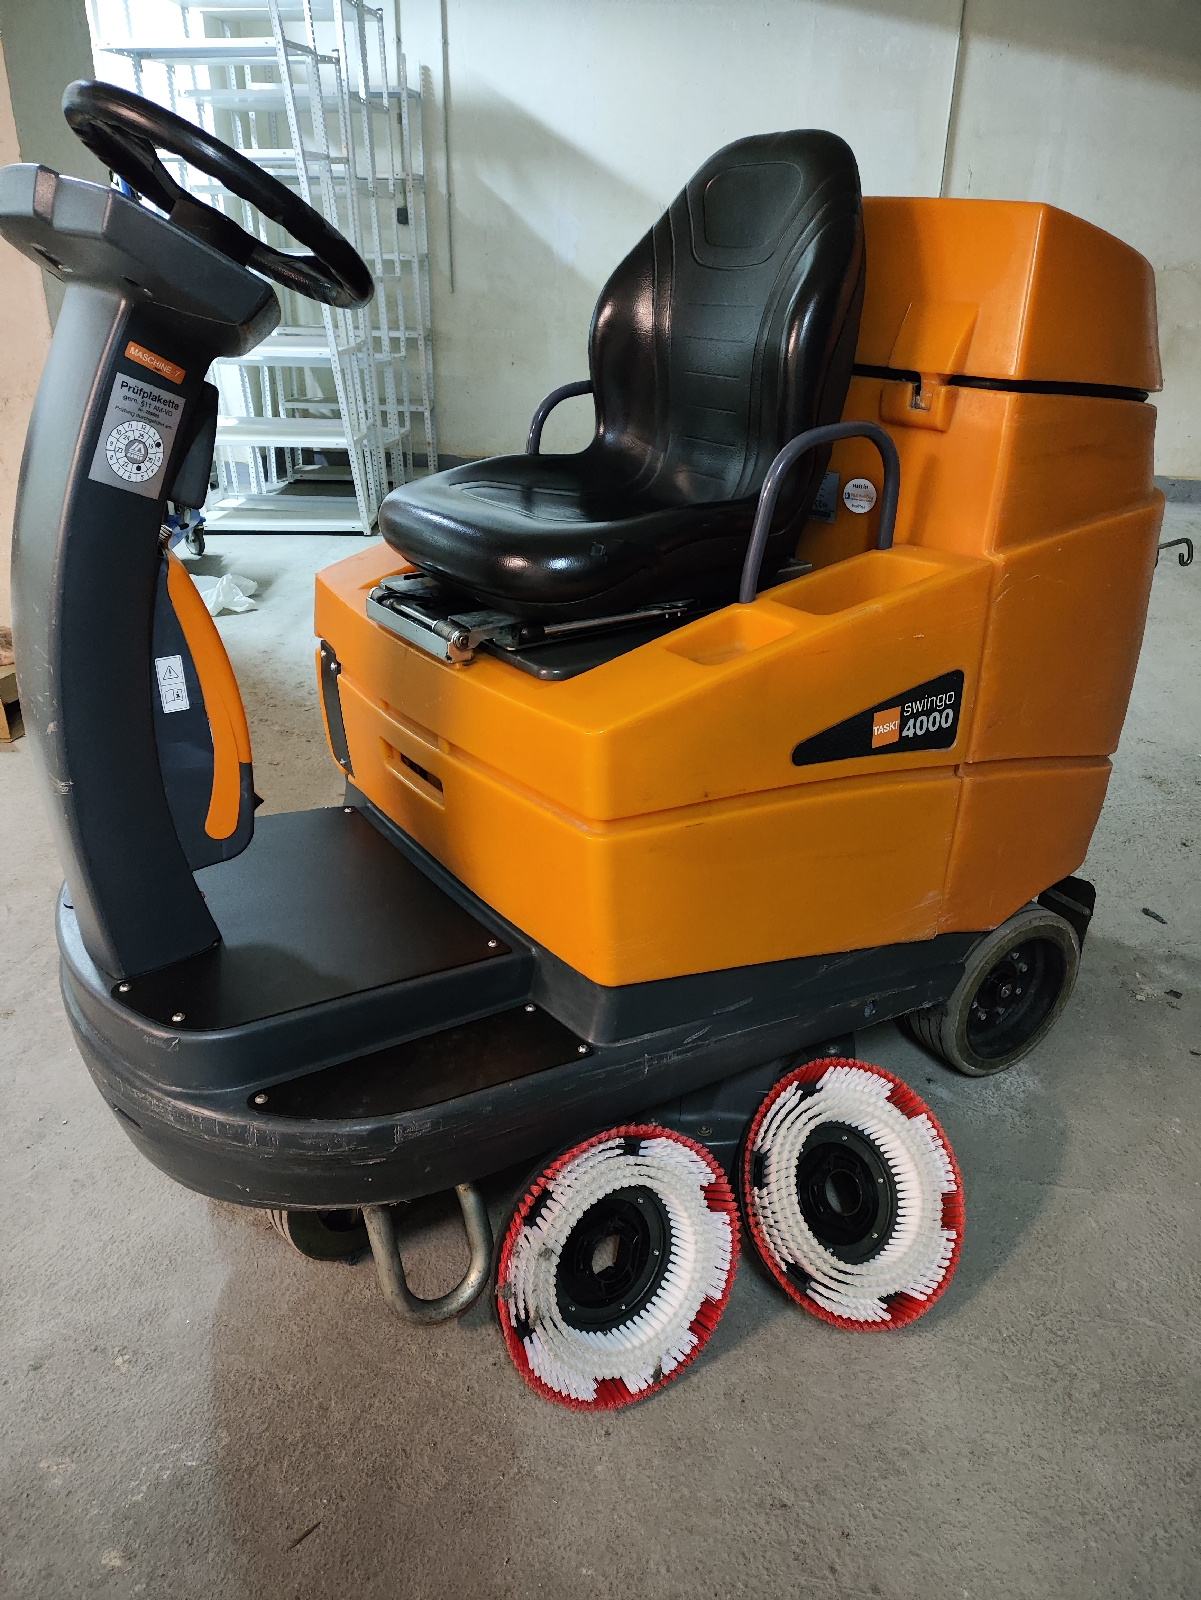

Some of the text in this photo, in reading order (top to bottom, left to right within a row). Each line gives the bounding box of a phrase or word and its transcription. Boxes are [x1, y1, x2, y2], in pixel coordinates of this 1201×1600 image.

[129, 347, 172, 373] MASCHINE
[120, 381, 180, 410] Prüfplakette
[903, 691, 955, 716] swingo
[873, 720, 899, 736] TASKI
[901, 708, 954, 738] 4000
